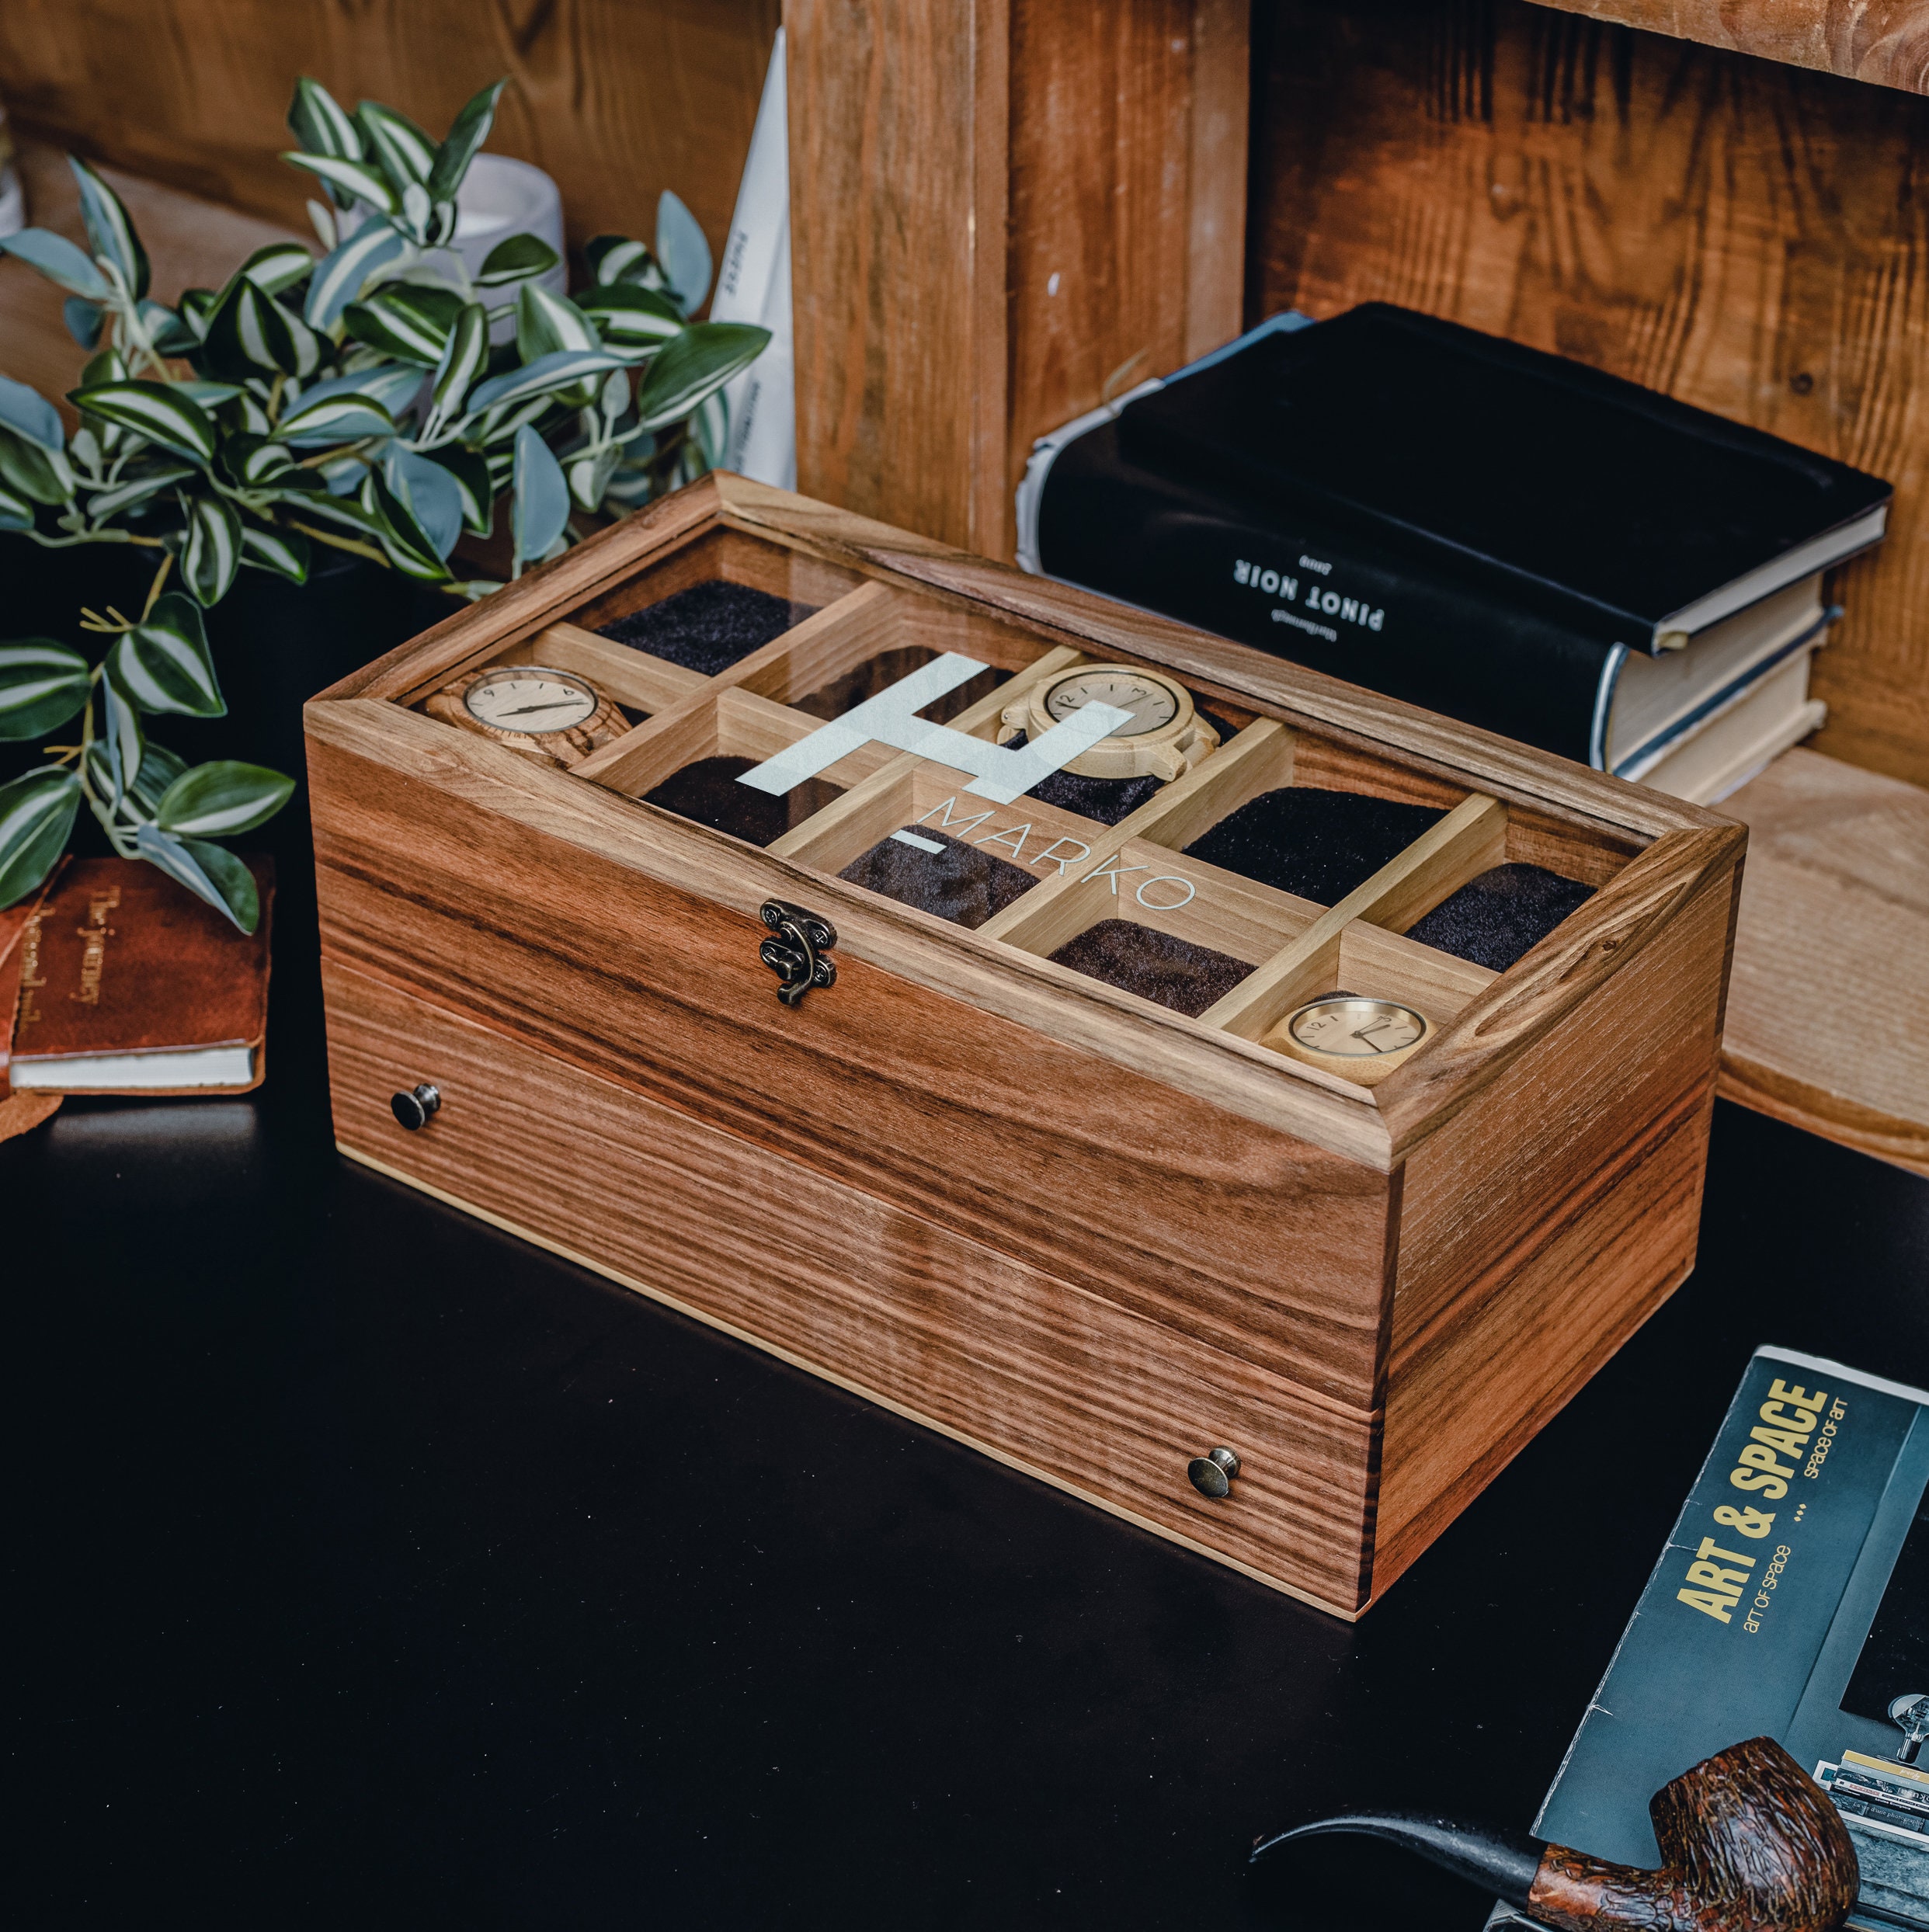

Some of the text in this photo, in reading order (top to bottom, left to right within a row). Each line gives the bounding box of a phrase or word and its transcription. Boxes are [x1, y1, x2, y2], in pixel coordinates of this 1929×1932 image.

[1233, 559, 1385, 631] PINOT NOIR
[916, 796, 1197, 911] MARKO
[1676, 1378, 1828, 1624] ART & SPACE
